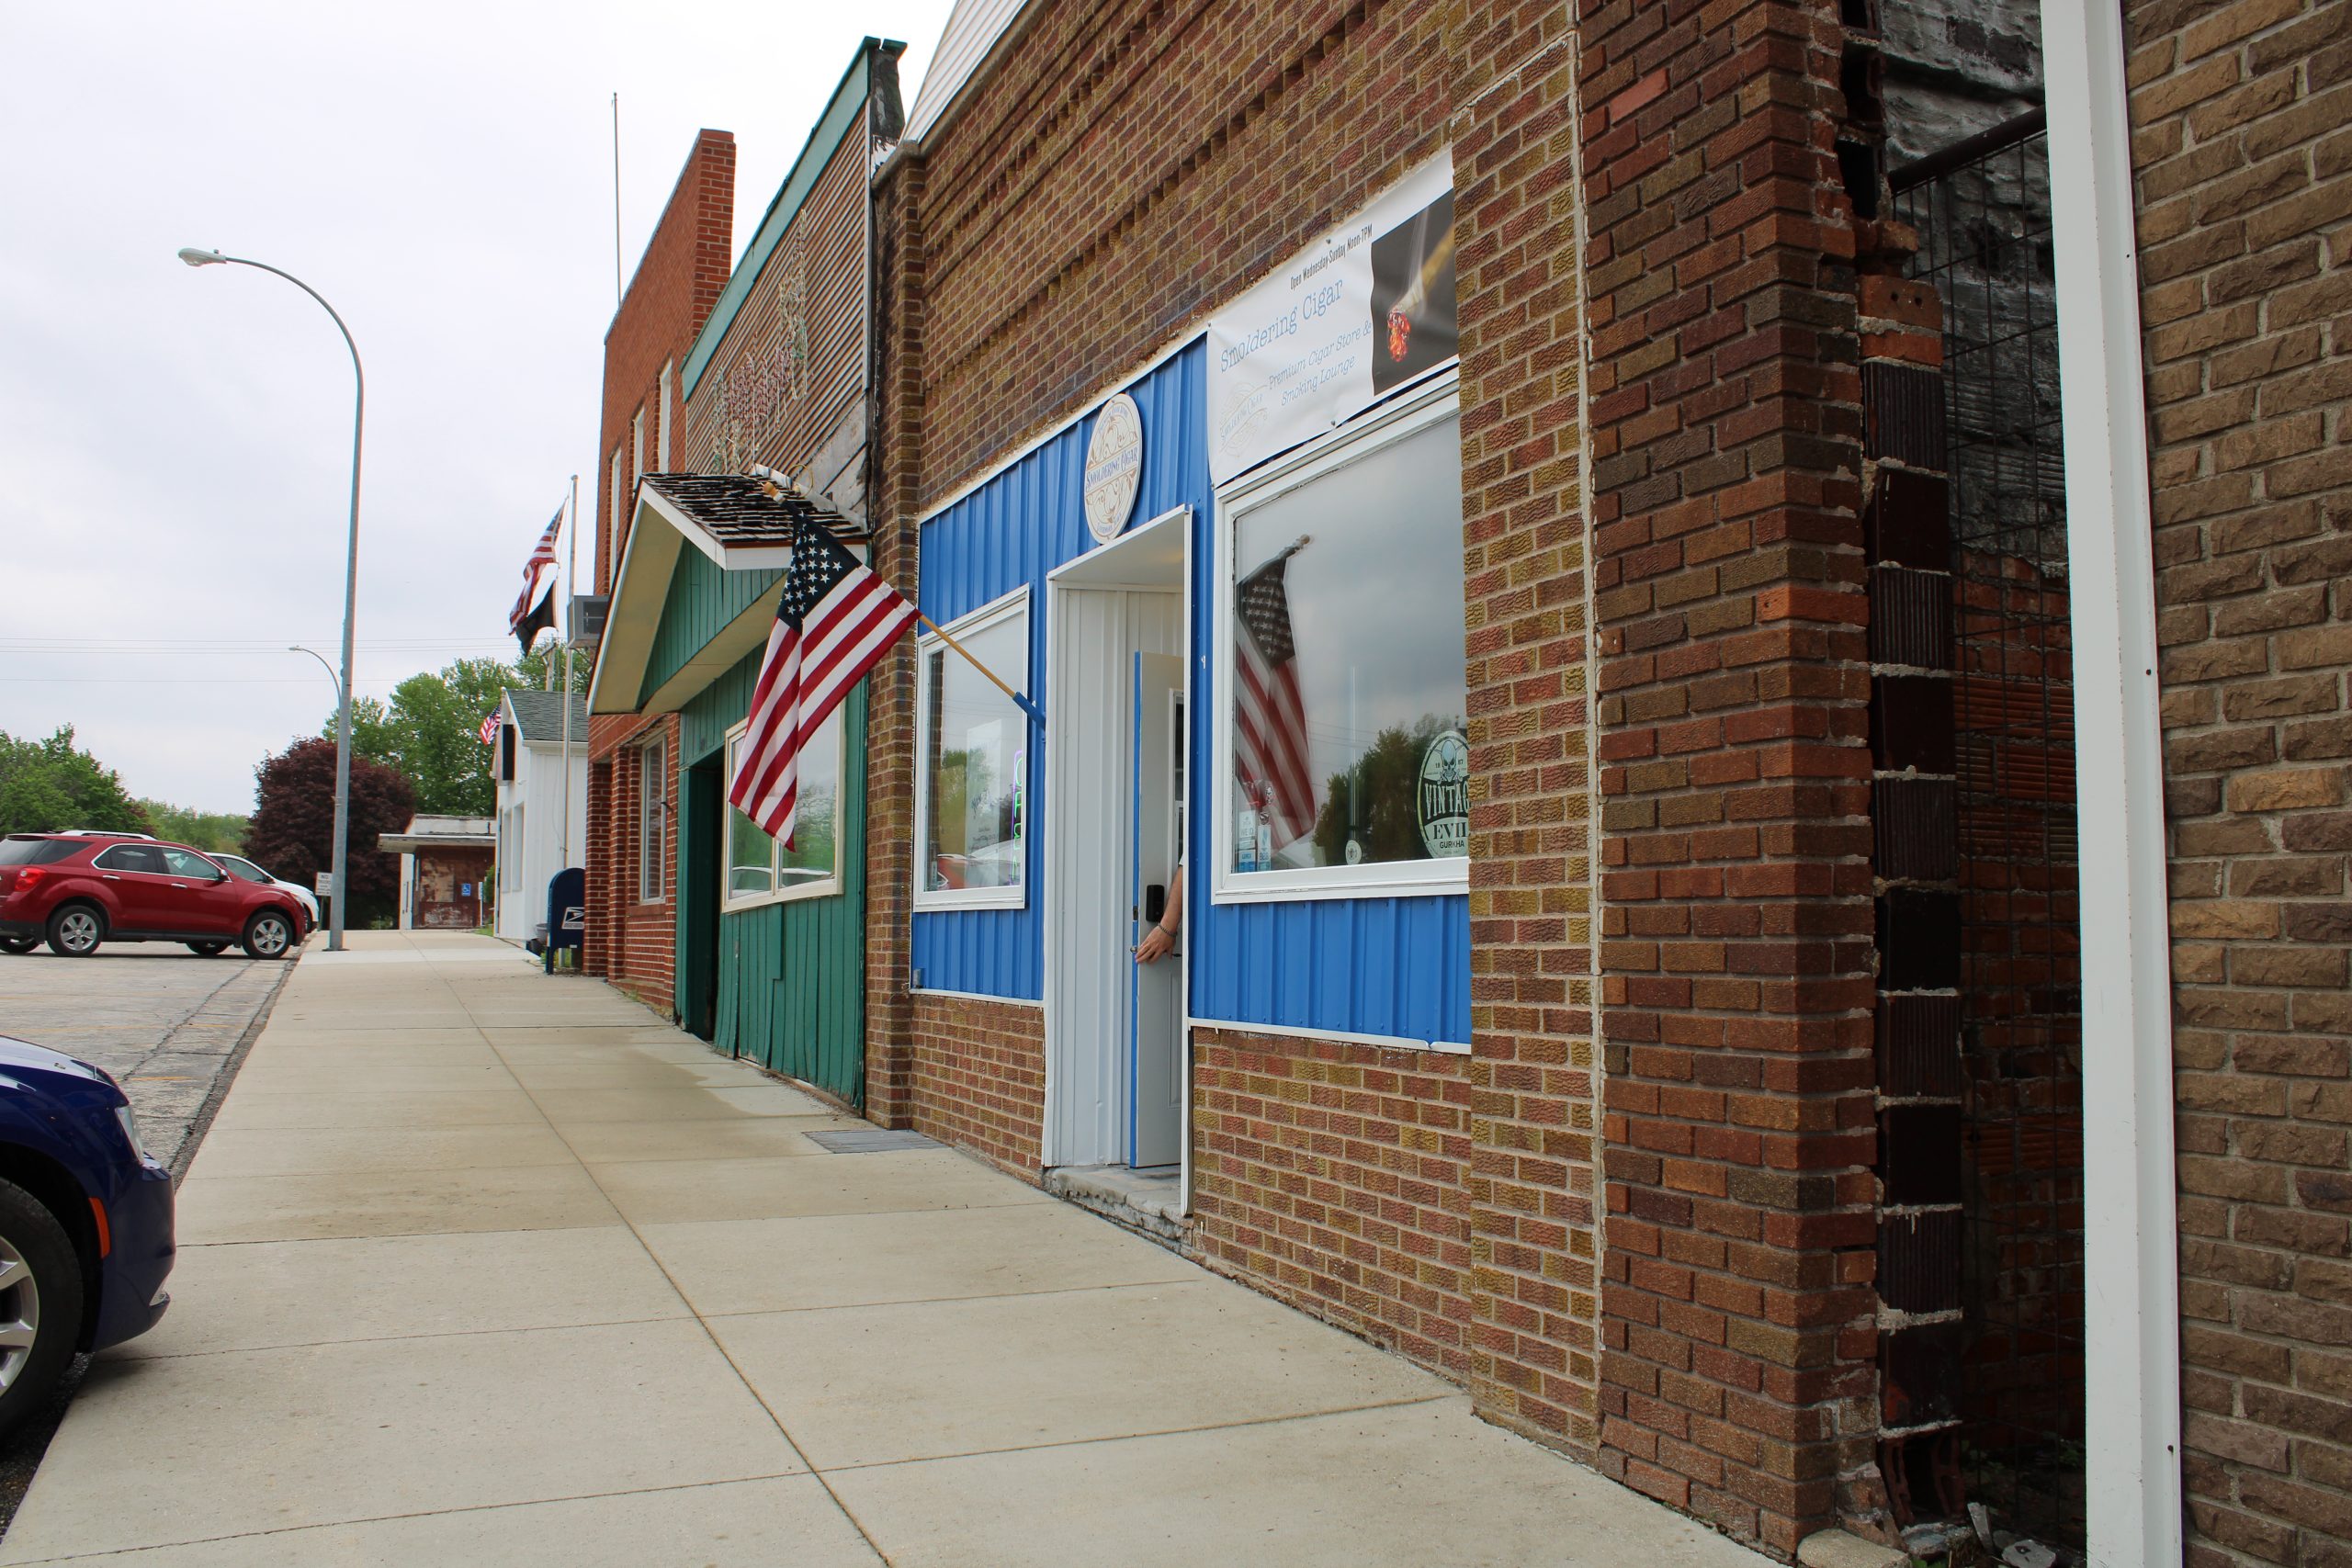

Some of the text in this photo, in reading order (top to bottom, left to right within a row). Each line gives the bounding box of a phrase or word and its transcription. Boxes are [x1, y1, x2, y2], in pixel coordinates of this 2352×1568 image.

[1290, 274, 1302, 291] Open
[1221, 279, 1343, 373] Smoldering Cigar
[1269, 320, 1372, 390] Premium Cigar Store &
[1282, 355, 1355, 406] Smoking Lounge
[1424, 781, 1469, 820] VINTAG
[1439, 840, 1464, 849] GURKHA
